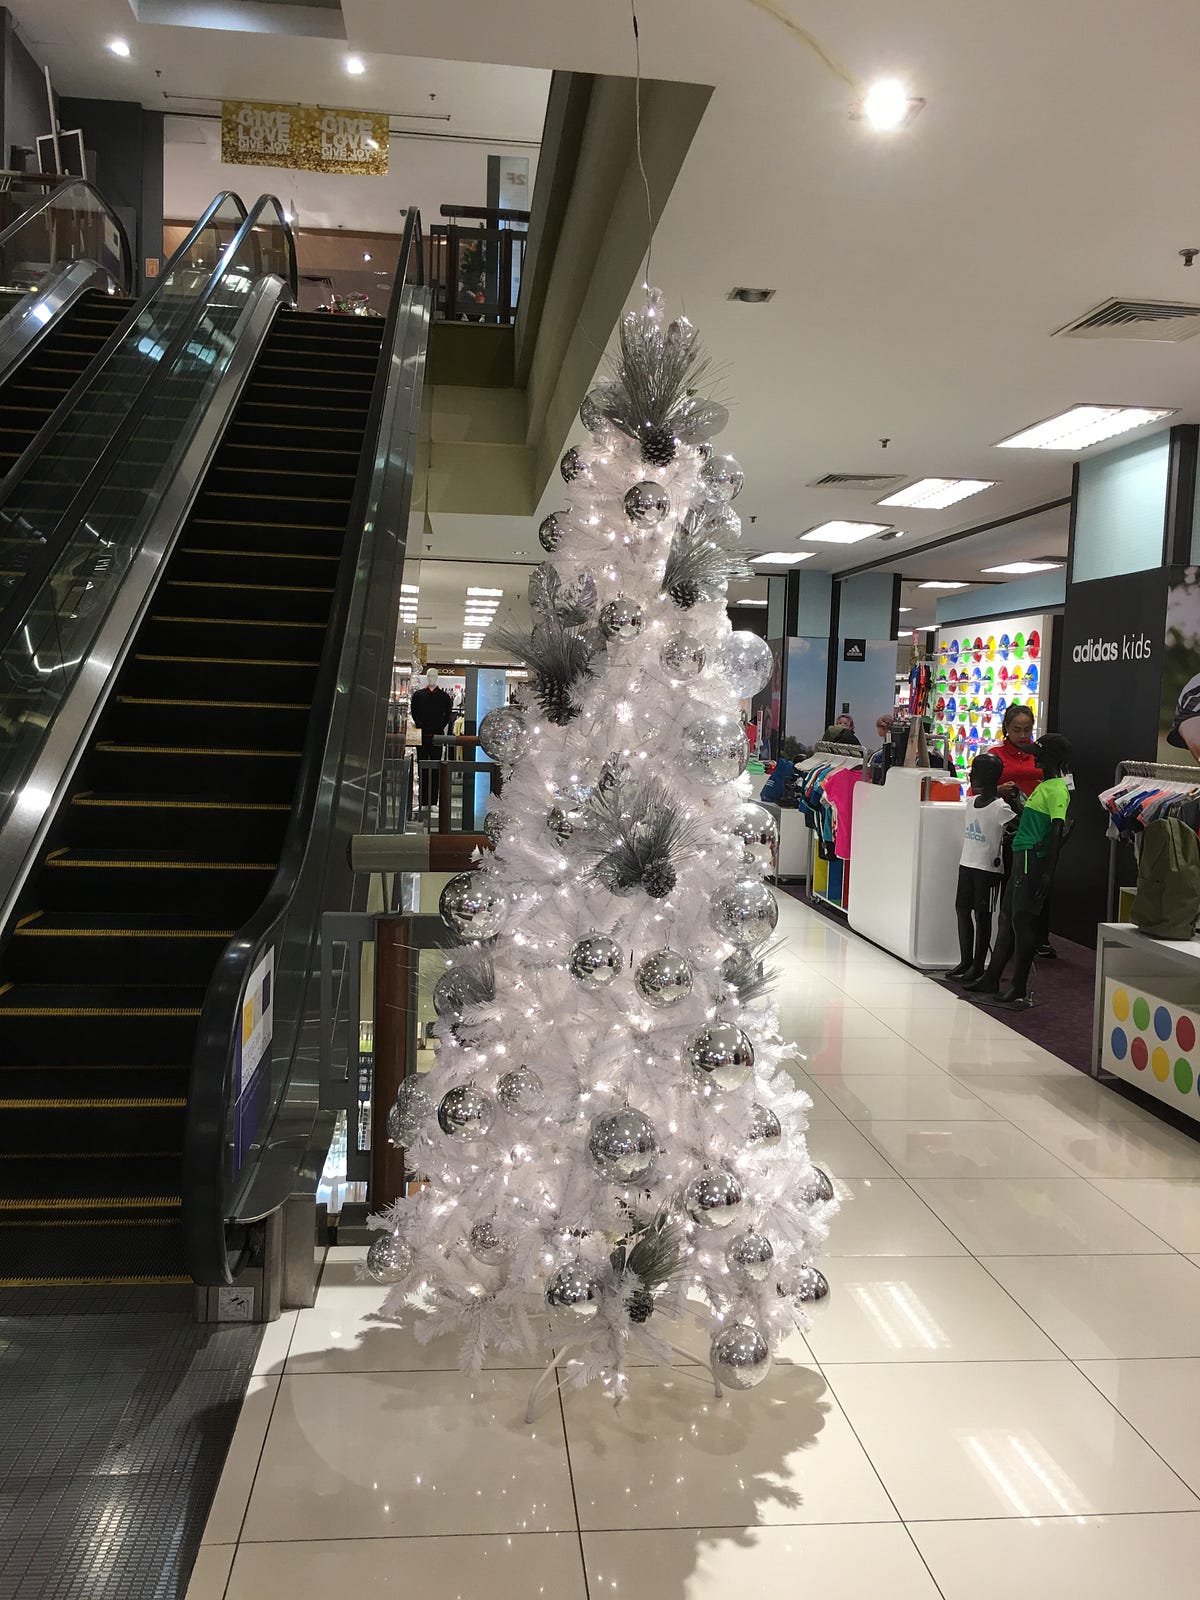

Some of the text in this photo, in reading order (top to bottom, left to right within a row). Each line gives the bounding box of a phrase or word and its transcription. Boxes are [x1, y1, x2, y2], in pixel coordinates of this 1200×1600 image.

[239, 109, 292, 126] GIVE
[321, 116, 373, 133] GIVE
[238, 124, 291, 143] LOVE
[322, 132, 374, 149] LOVE
[239, 139, 289, 151] GIVE JOY
[322, 147, 372, 158] GIVE JOY
[1073, 633, 1151, 662] adidas kids
